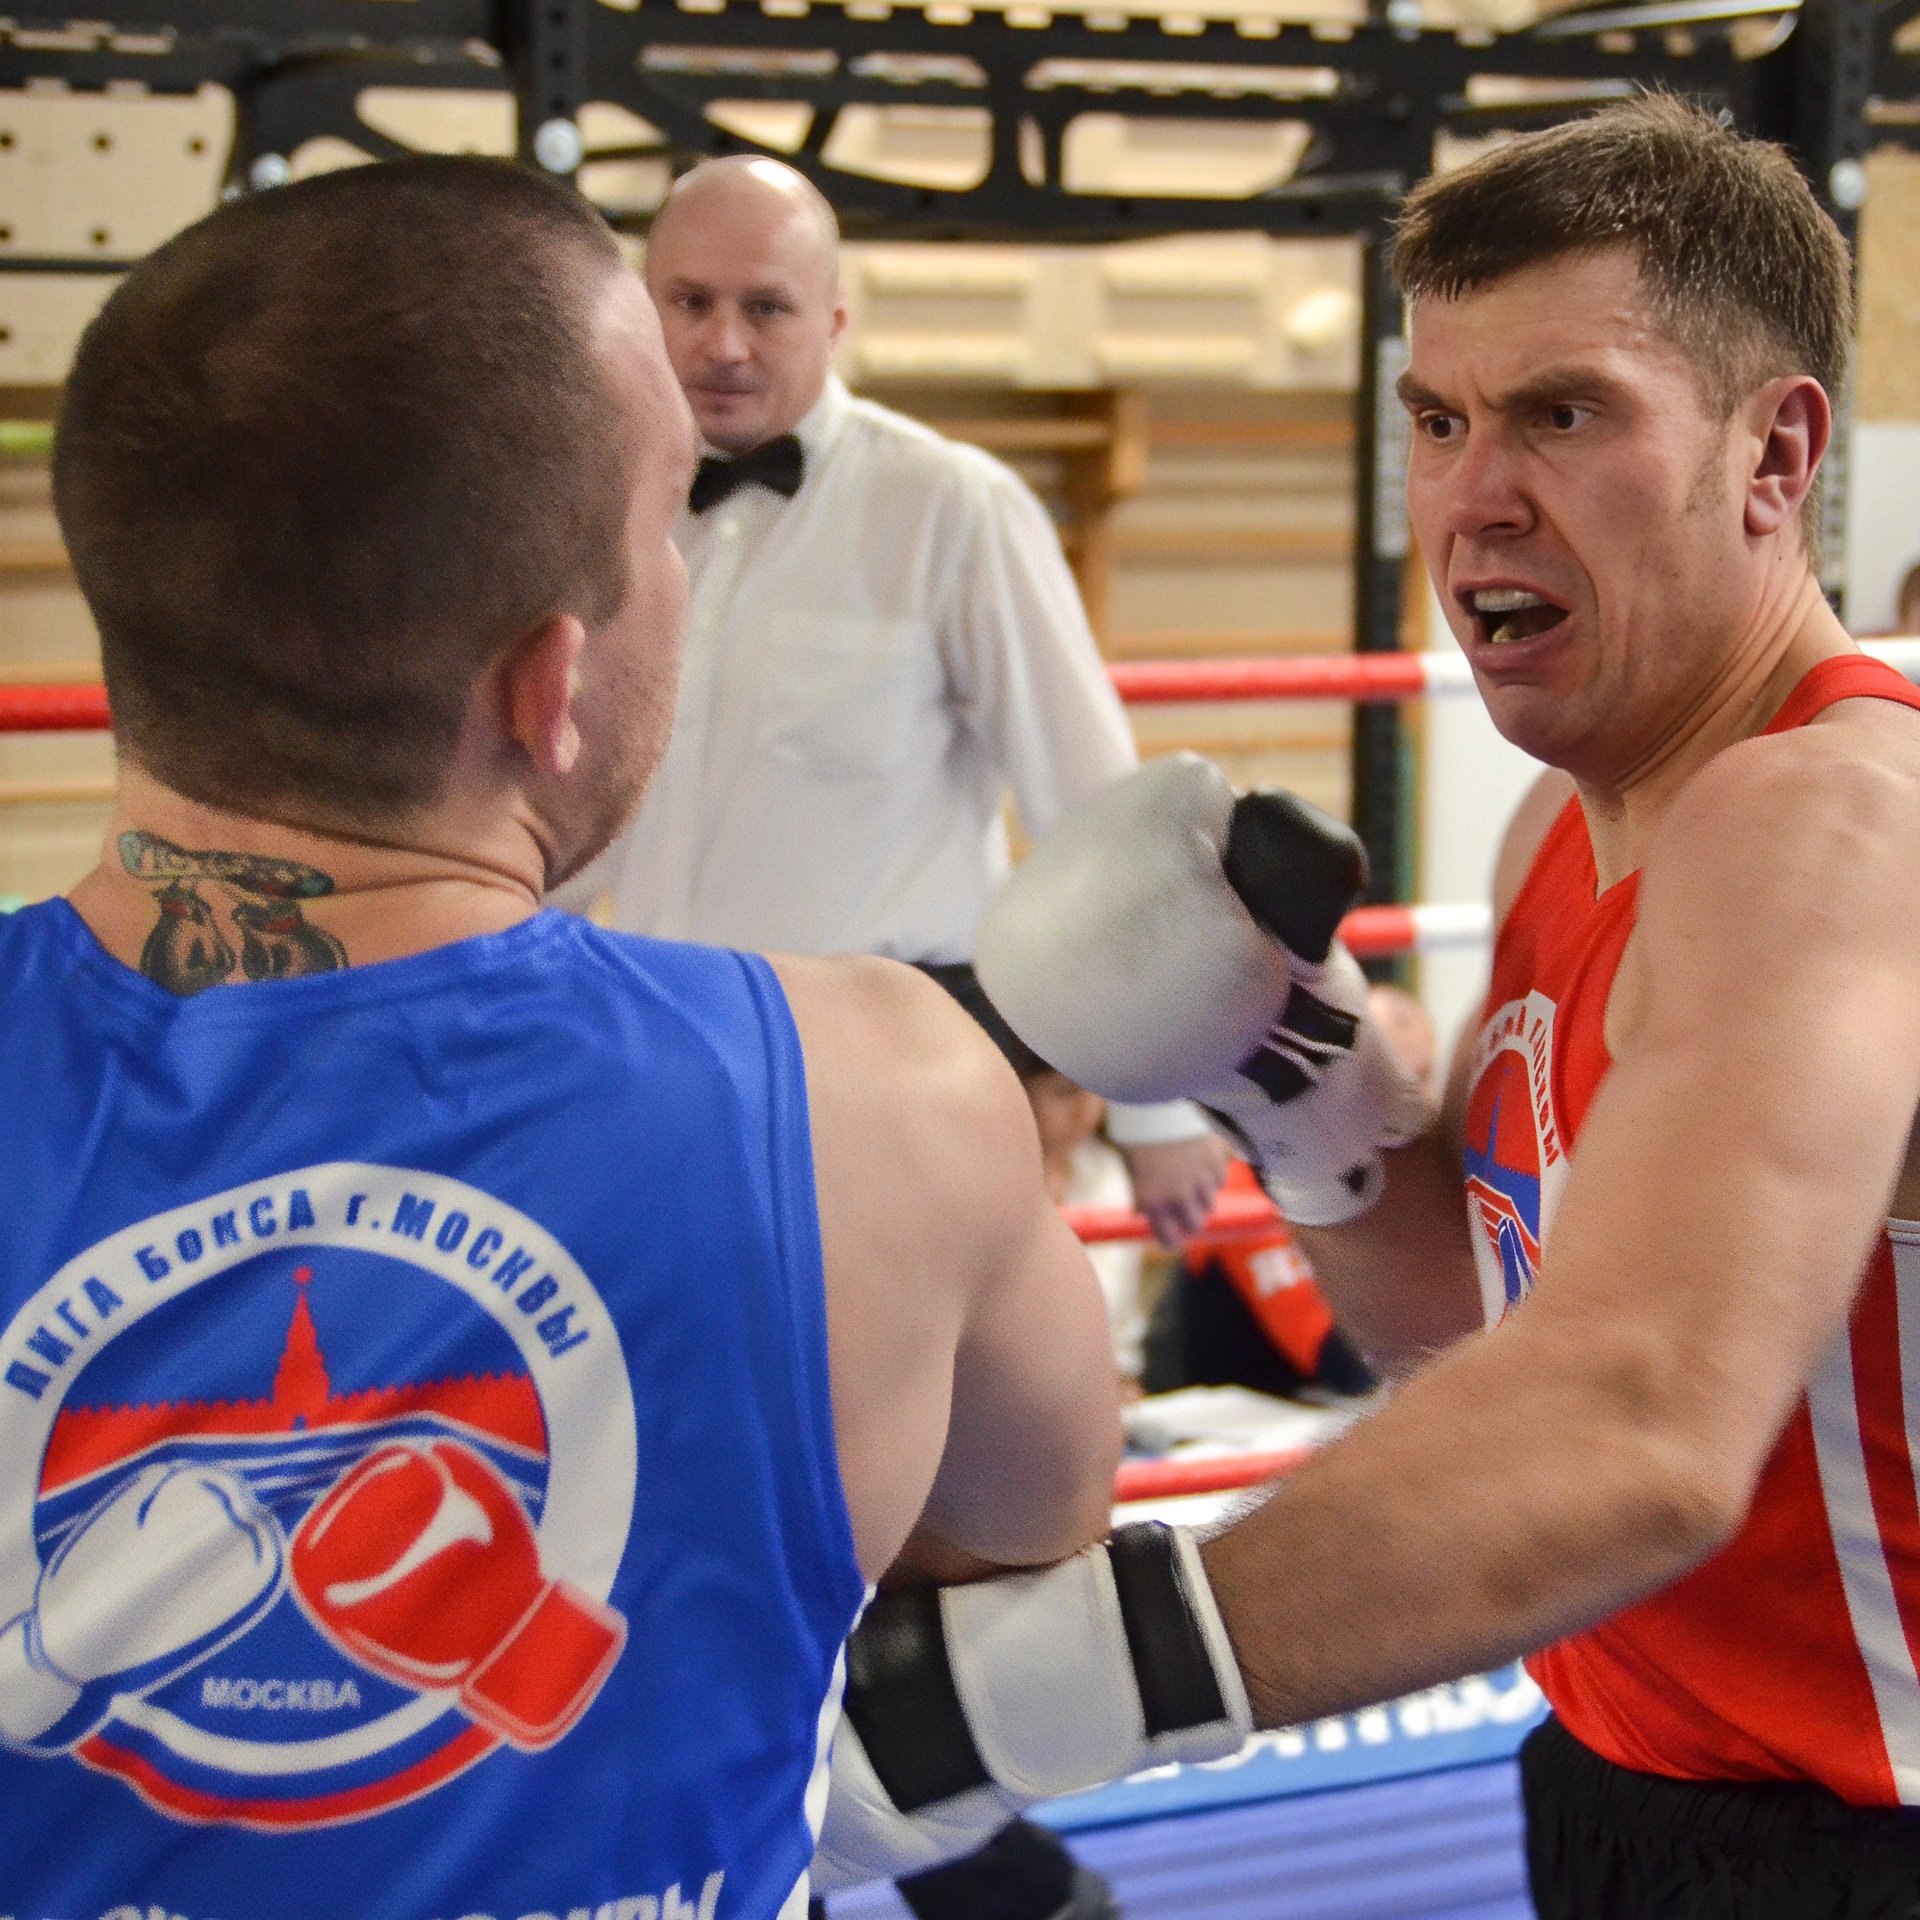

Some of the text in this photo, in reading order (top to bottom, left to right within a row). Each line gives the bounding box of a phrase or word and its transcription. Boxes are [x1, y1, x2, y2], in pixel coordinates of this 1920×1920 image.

[4, 1275, 124, 1401] ЛИГА
[134, 1188, 315, 1283] БОКСА
[202, 1677, 361, 1711] МОСКВА
